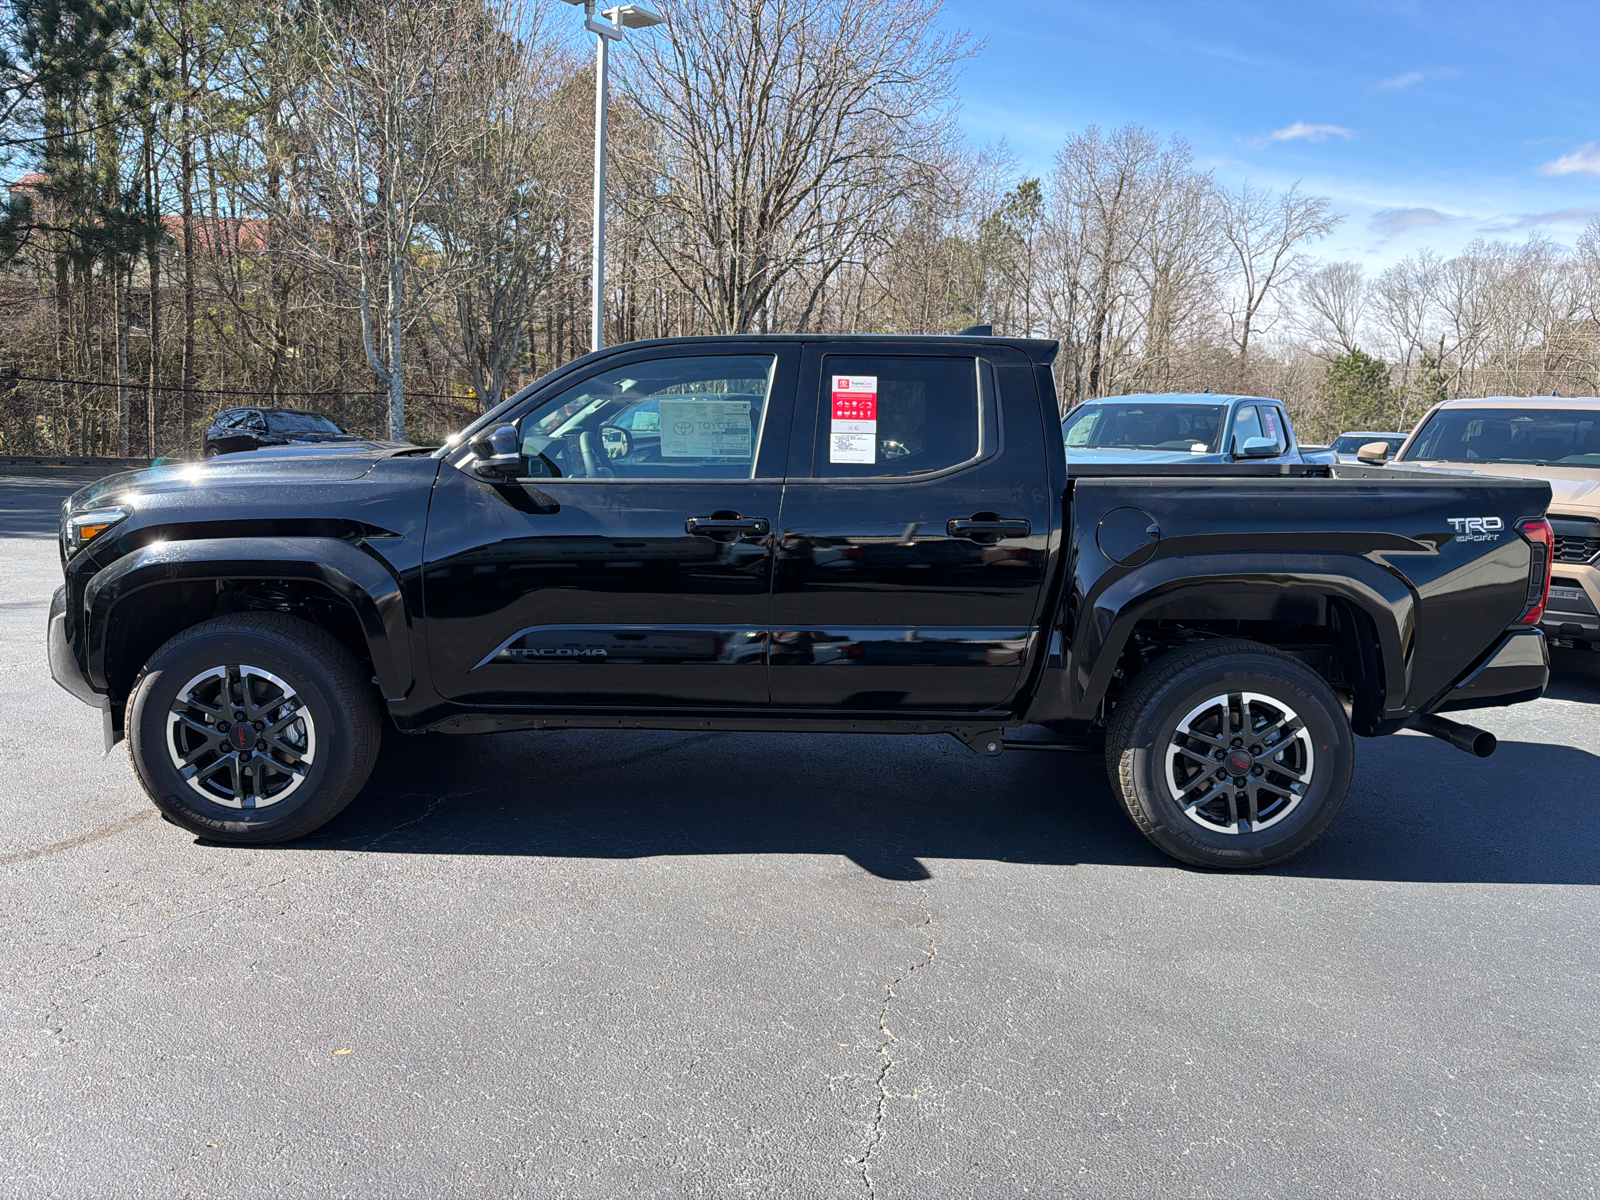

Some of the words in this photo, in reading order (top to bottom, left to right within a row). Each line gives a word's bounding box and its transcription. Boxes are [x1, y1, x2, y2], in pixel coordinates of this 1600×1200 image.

[696, 421, 738, 430] TOYOTA
[1447, 517, 1502, 534] TRD
[1455, 534, 1500, 542] SPORT
[509, 648, 608, 656] TACOMA
[238, 727, 246, 748] TRD
[1231, 757, 1249, 770] TRD
[166, 794, 223, 829] MICHELIN
